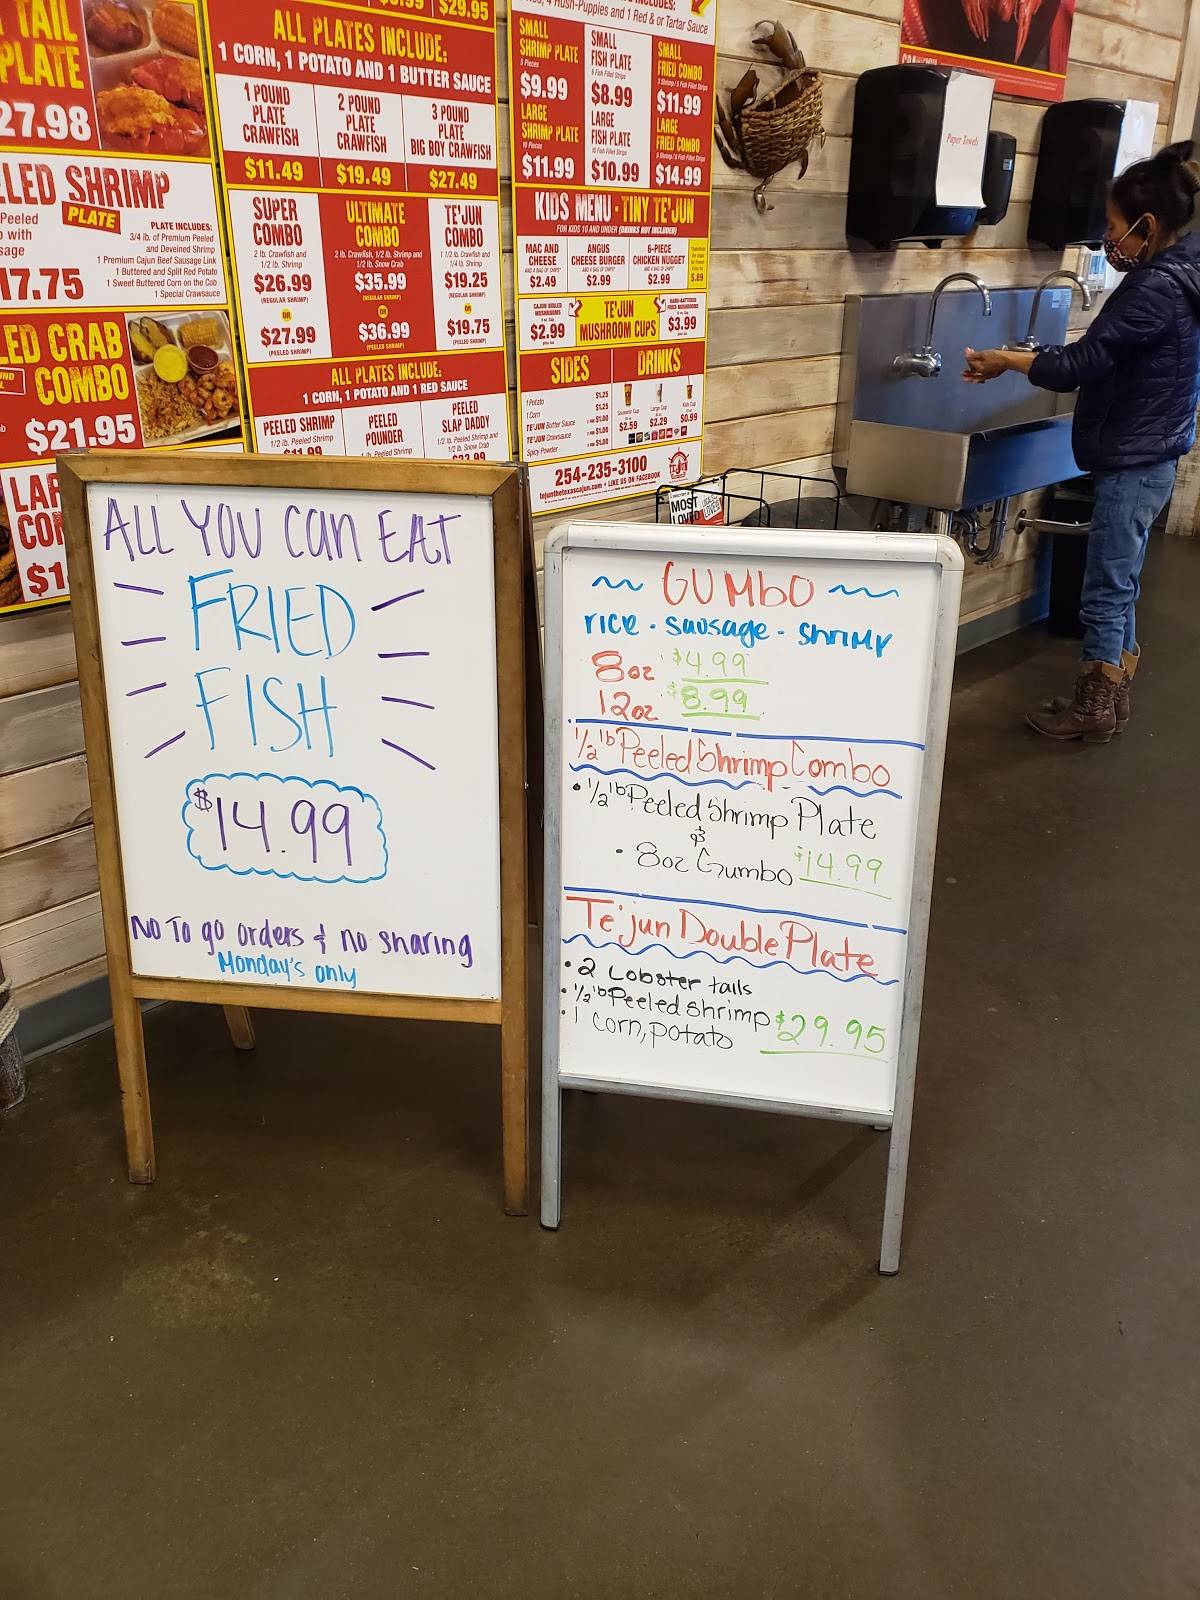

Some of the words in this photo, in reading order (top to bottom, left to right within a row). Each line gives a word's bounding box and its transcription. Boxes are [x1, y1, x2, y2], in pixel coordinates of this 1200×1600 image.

[273, 9, 306, 44] ALL
[313, 16, 375, 53] PLATES
[380, 25, 448, 63] INCLUDE:
[519, 17, 548, 39] SMALL
[591, 30, 617, 49] SMALL
[520, 71, 568, 101] $9.99
[591, 80, 633, 107] $8.99
[521, 102, 548, 122] LARGE
[656, 89, 701, 116] $11.99
[252, 106, 286, 125] PLATE
[346, 115, 376, 133] PLATE
[591, 110, 614, 127] LARGE
[243, 124, 299, 146] CRAWFISH
[337, 132, 387, 153] CRAWFISH
[946, 133, 961, 146] Paper
[244, 156, 304, 182] $11.49
[337, 163, 392, 186] $19.49
[522, 152, 574, 179] $11.99
[591, 158, 640, 183] $10.99
[655, 162, 701, 186] $14.99
[0, 162, 56, 205] LED
[65, 165, 170, 209] SHRIMP
[429, 169, 478, 190] $27.49
[1, 212, 38, 225] Peeled
[67, 208, 116, 229] PLATE
[252, 197, 298, 221] SUPER
[346, 200, 405, 224] ULTIMATE
[535, 192, 569, 221] KIDS
[575, 194, 612, 222] MENU
[621, 196, 650, 223] TINY
[654, 197, 695, 224] TE'JUN
[8, 228, 32, 240] with
[151, 222, 174, 230] PLATE
[175, 223, 213, 231] INCLUDES:
[253, 223, 303, 246] COMBO
[355, 225, 399, 247] COMBO
[445, 227, 483, 247] COMBO
[130, 233, 141, 241] 3/4
[152, 233, 160, 241] of
[161, 234, 191, 242] Premium
[192, 234, 214, 243] Peeled
[526, 244, 542, 253] MAC
[544, 244, 559, 253] AND
[587, 244, 610, 253] ANGUS
[647, 244, 671, 253] 6-PIECE
[103, 256, 135, 264] Premium
[136, 256, 156, 265] Cajun
[157, 256, 173, 264] Beef
[174, 257, 202, 265] Sausage
[203, 257, 216, 265] Link
[160, 245, 191, 253] Deveined
[192, 246, 215, 255] Shrimp
[529, 256, 556, 266] CHEESE
[571, 256, 599, 266] CHEESE
[600, 256, 625, 265] BURGER
[633, 255, 662, 265] CHICKEN
[663, 255, 685, 265] NUGGET
[122, 268, 151, 276] Buttered
[153, 268, 165, 276] and
[167, 268, 182, 277] Split
[183, 268, 196, 276] Red
[197, 268, 217, 276] Potato
[254, 273, 311, 294] $26.99
[355, 271, 406, 292] $35.99
[47, 321, 123, 362] CRAB
[260, 326, 316, 347] $27.99
[359, 321, 410, 342] $36.99
[530, 323, 565, 341] $2.99
[580, 321, 631, 342] MUSHROOM
[634, 320, 656, 337] CUPS
[551, 355, 590, 384] SIDES
[637, 348, 681, 376] DRINKS
[35, 363, 130, 406] COMBO
[331, 366, 352, 386] ALL
[355, 363, 395, 385] PLATES
[398, 361, 442, 380] INCLUDE:
[263, 418, 298, 437] PEELED
[299, 414, 335, 432] SHRIMP
[368, 412, 398, 429] PEELED
[619, 421, 637, 432] $2.59
[650, 417, 667, 427] $2.29
[681, 413, 697, 422] $0.99
[25, 413, 136, 455] $21.95
[291, 436, 312, 446] Peeled
[312, 434, 334, 445] Shrimp
[365, 429, 403, 447] POUNDER
[555, 455, 648, 486] 254-235-3100
[104, 497, 174, 562] ALL
[180, 499, 262, 559] YOU
[379, 509, 462, 565] EAT
[187, 568, 356, 659] FRIED
[584, 613, 640, 636] rice
[665, 615, 770, 649] sausage
[591, 650, 655, 683] 8oz
[672, 648, 747, 677] $4.99
[195, 666, 337, 758] FISH
[599, 690, 658, 722] 12oz
[666, 682, 749, 713] $8.99
[616, 726, 693, 774] Peeled
[697, 737, 788, 792] Shrimp
[788, 740, 891, 787] Combo
[627, 786, 701, 822] Peeled
[708, 797, 788, 840] Shrimp
[791, 797, 877, 840] Plate
[193, 788, 353, 867] $14.99
[636, 841, 689, 873] 8oz
[696, 848, 793, 886] Gumbo
[793, 846, 882, 884] $14.99
[201, 920, 224, 955] go
[238, 918, 305, 949] orders
[341, 929, 369, 954] no
[679, 908, 777, 956] Double
[780, 920, 879, 977] Plate
[217, 951, 305, 978] Monday's
[315, 964, 356, 989] only
[577, 958, 597, 976] 2
[709, 975, 753, 997] tails
[687, 999, 771, 1032] shrimp
[776, 1010, 886, 1054] $29.95
